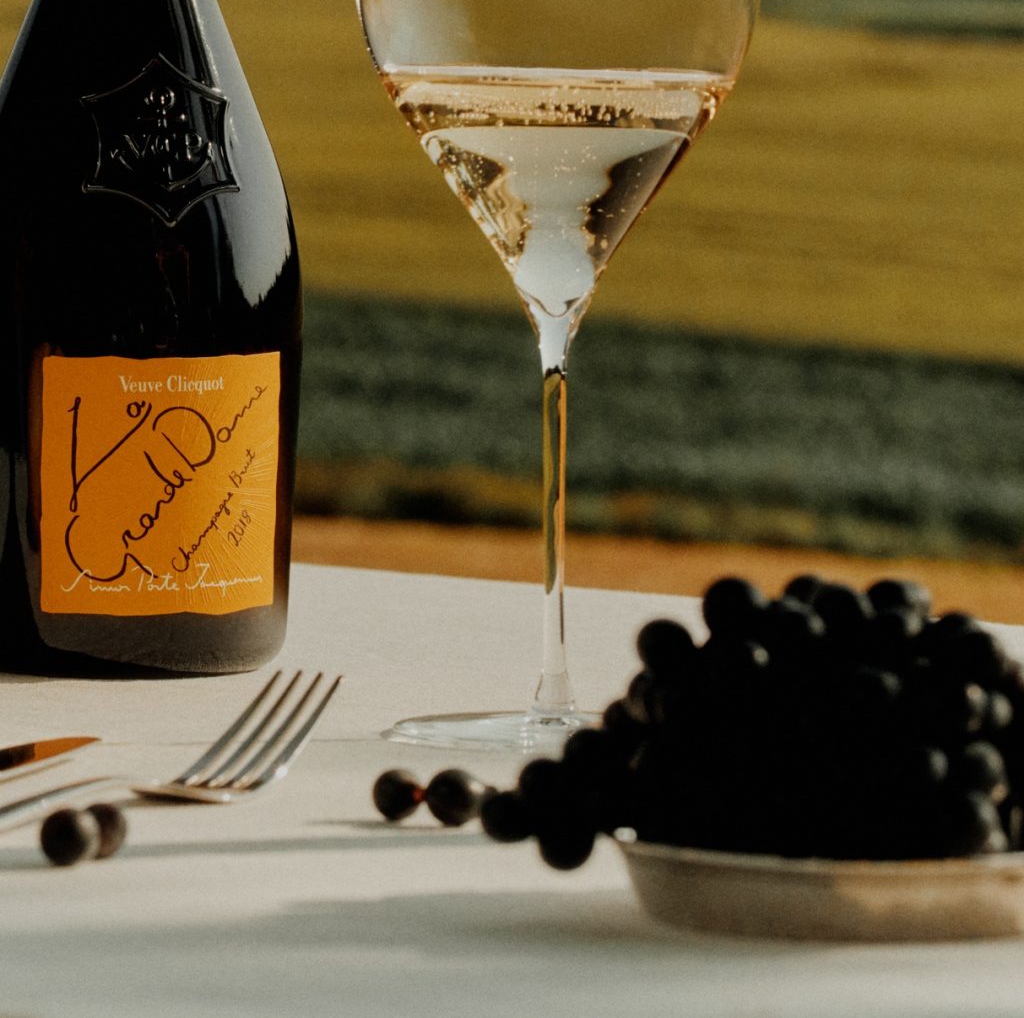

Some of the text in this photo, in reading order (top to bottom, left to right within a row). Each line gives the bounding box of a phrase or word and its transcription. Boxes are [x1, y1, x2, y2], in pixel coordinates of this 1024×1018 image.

[119, 374, 225, 395] Veuve Clicquot
[64, 385, 267, 582] Grande Dame
[67, 396, 153, 512] La
[171, 448, 256, 572] Champagne Brut
[227, 509, 252, 547] 2018
